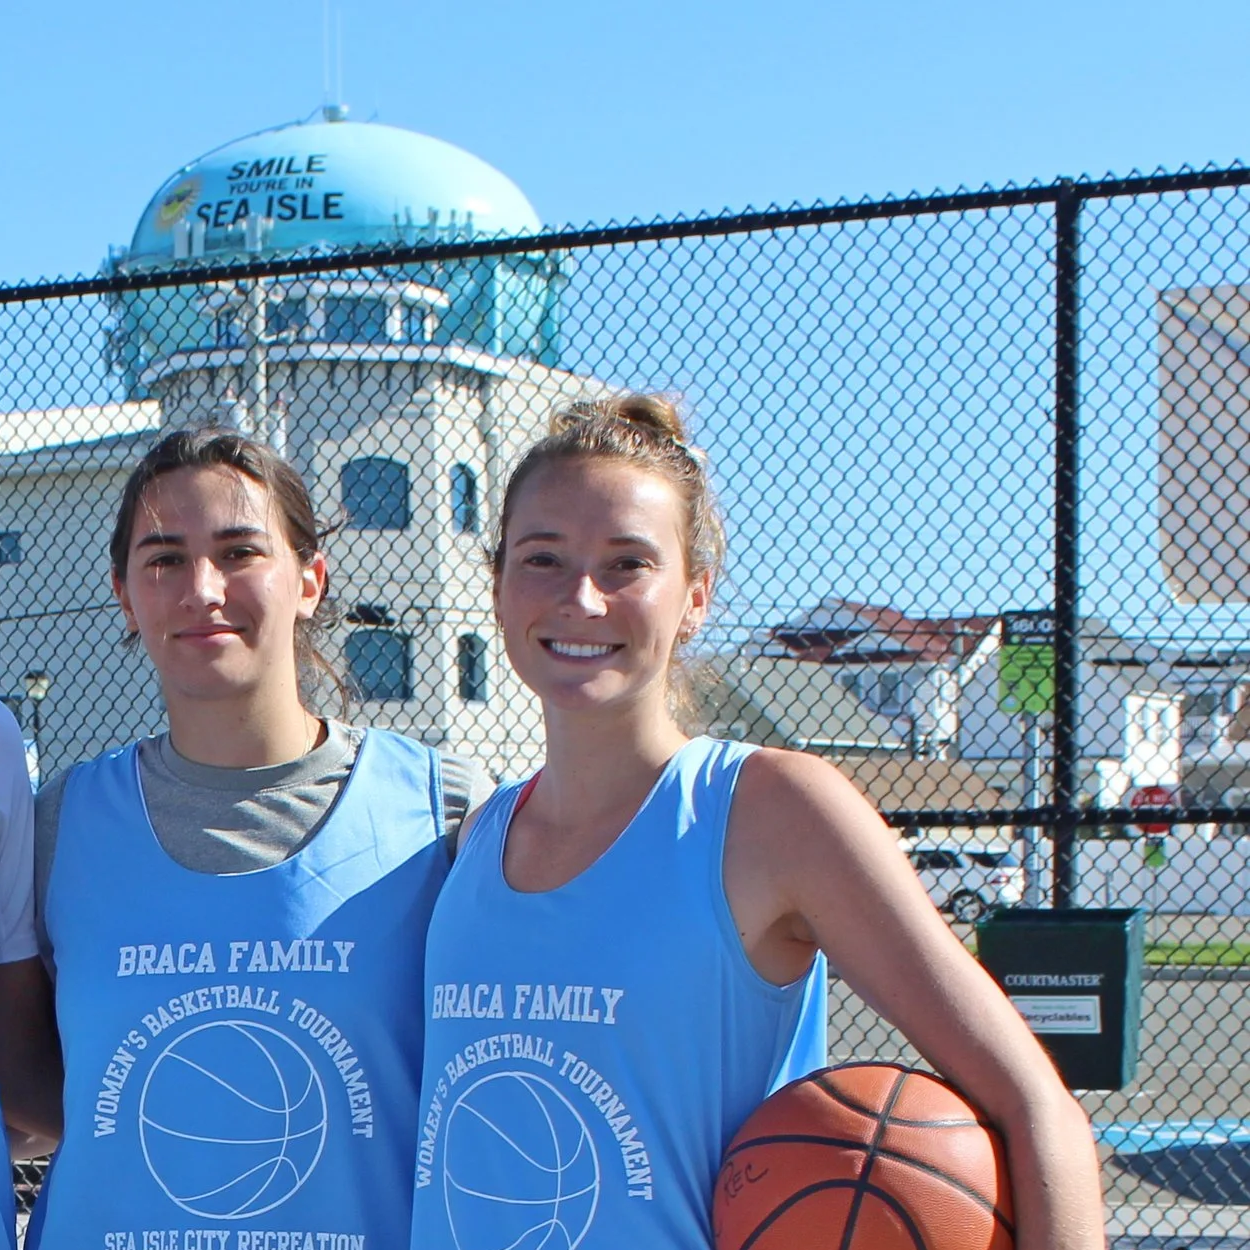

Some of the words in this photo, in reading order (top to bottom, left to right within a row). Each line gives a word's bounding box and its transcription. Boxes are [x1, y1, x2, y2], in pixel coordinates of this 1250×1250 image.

[227, 154, 327, 181] SMILE
[230, 177, 288, 195] YOU'RE
[295, 177, 314, 190] IN
[196, 197, 250, 228] SEA
[266, 192, 344, 221] ISLE
[117, 943, 216, 977] BRACA
[228, 940, 355, 973] FAMILY
[1004, 974, 1101, 986] COURTMASTER
[432, 983, 504, 1020] BRACA
[513, 985, 624, 1025] FAMILY
[94, 1030, 148, 1138] WOMEN'S
[141, 985, 280, 1037] BASKETBALL
[288, 998, 373, 1138] TOURNAMENT
[415, 1077, 448, 1189] WOMEN'S
[445, 1033, 554, 1085] BASKETBALL
[558, 1051, 654, 1201] TOURNAMENT
[722, 1159, 770, 1207] REC
